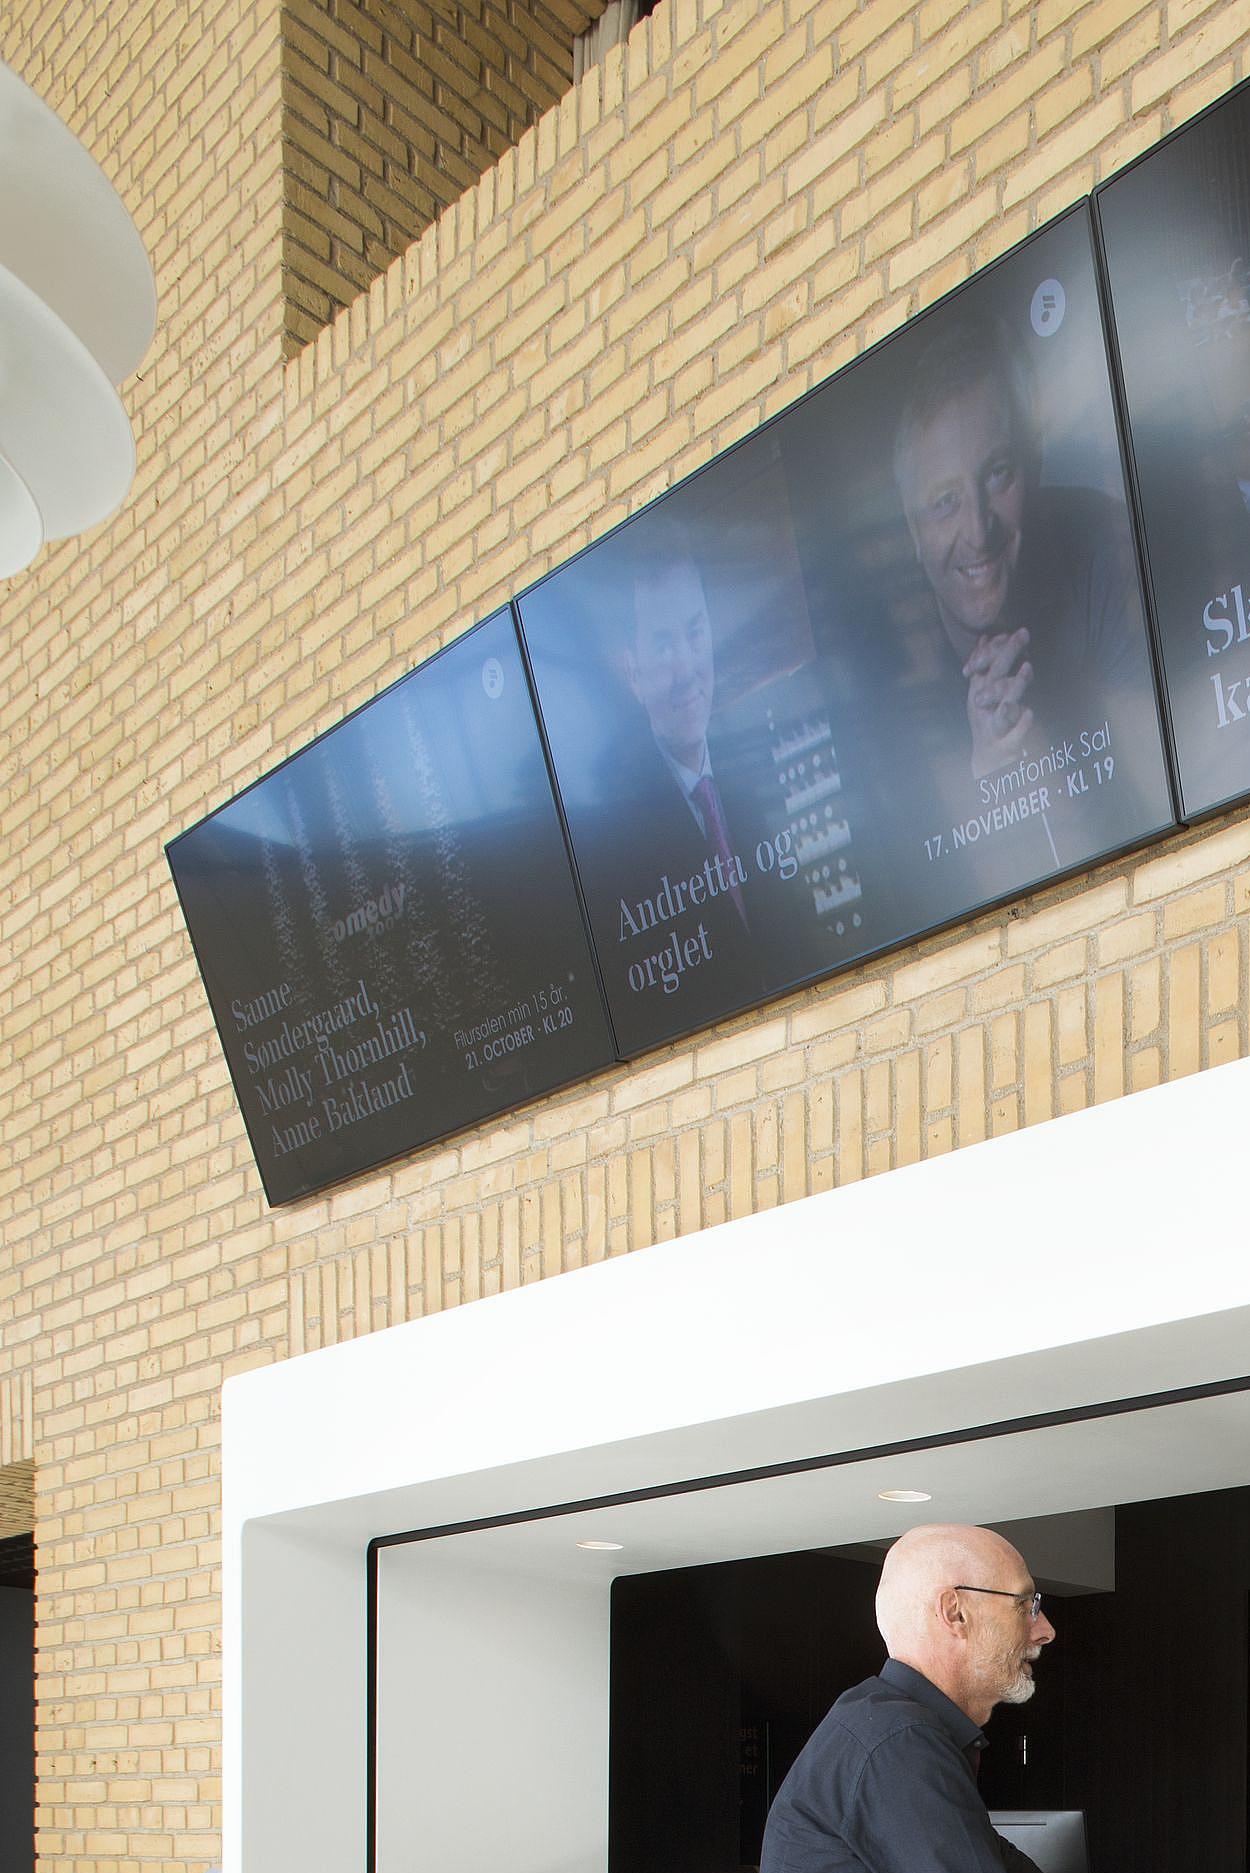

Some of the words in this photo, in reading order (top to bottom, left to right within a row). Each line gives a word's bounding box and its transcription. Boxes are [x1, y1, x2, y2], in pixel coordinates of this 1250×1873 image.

[979, 741, 1077, 805] Symfonisk
[1079, 721, 1111, 757] Sal
[924, 834, 949, 861] 17.
[952, 787, 1051, 849] NOVEMBER
[1066, 769, 1089, 797] KL
[1093, 756, 1114, 785] 19
[332, 881, 407, 943] omedy
[616, 853, 748, 943] Andretta
[756, 830, 799, 881] og
[628, 921, 713, 994] orglet
[232, 982, 293, 1032] Sanne
[245, 978, 380, 1074] Søndergaard,
[454, 1014, 507, 1050] Filursalen
[507, 1002, 531, 1025] min
[533, 991, 548, 1013] 15
[550, 984, 568, 1005] år.
[465, 1051, 483, 1070] 21.
[483, 1025, 535, 1061] OCTOBER
[543, 1017, 557, 1034] KL
[558, 1007, 573, 1028] 20
[255, 1066, 313, 1117] Molly
[314, 1008, 427, 1087] Thornhill,
[272, 1114, 321, 1157] Anne
